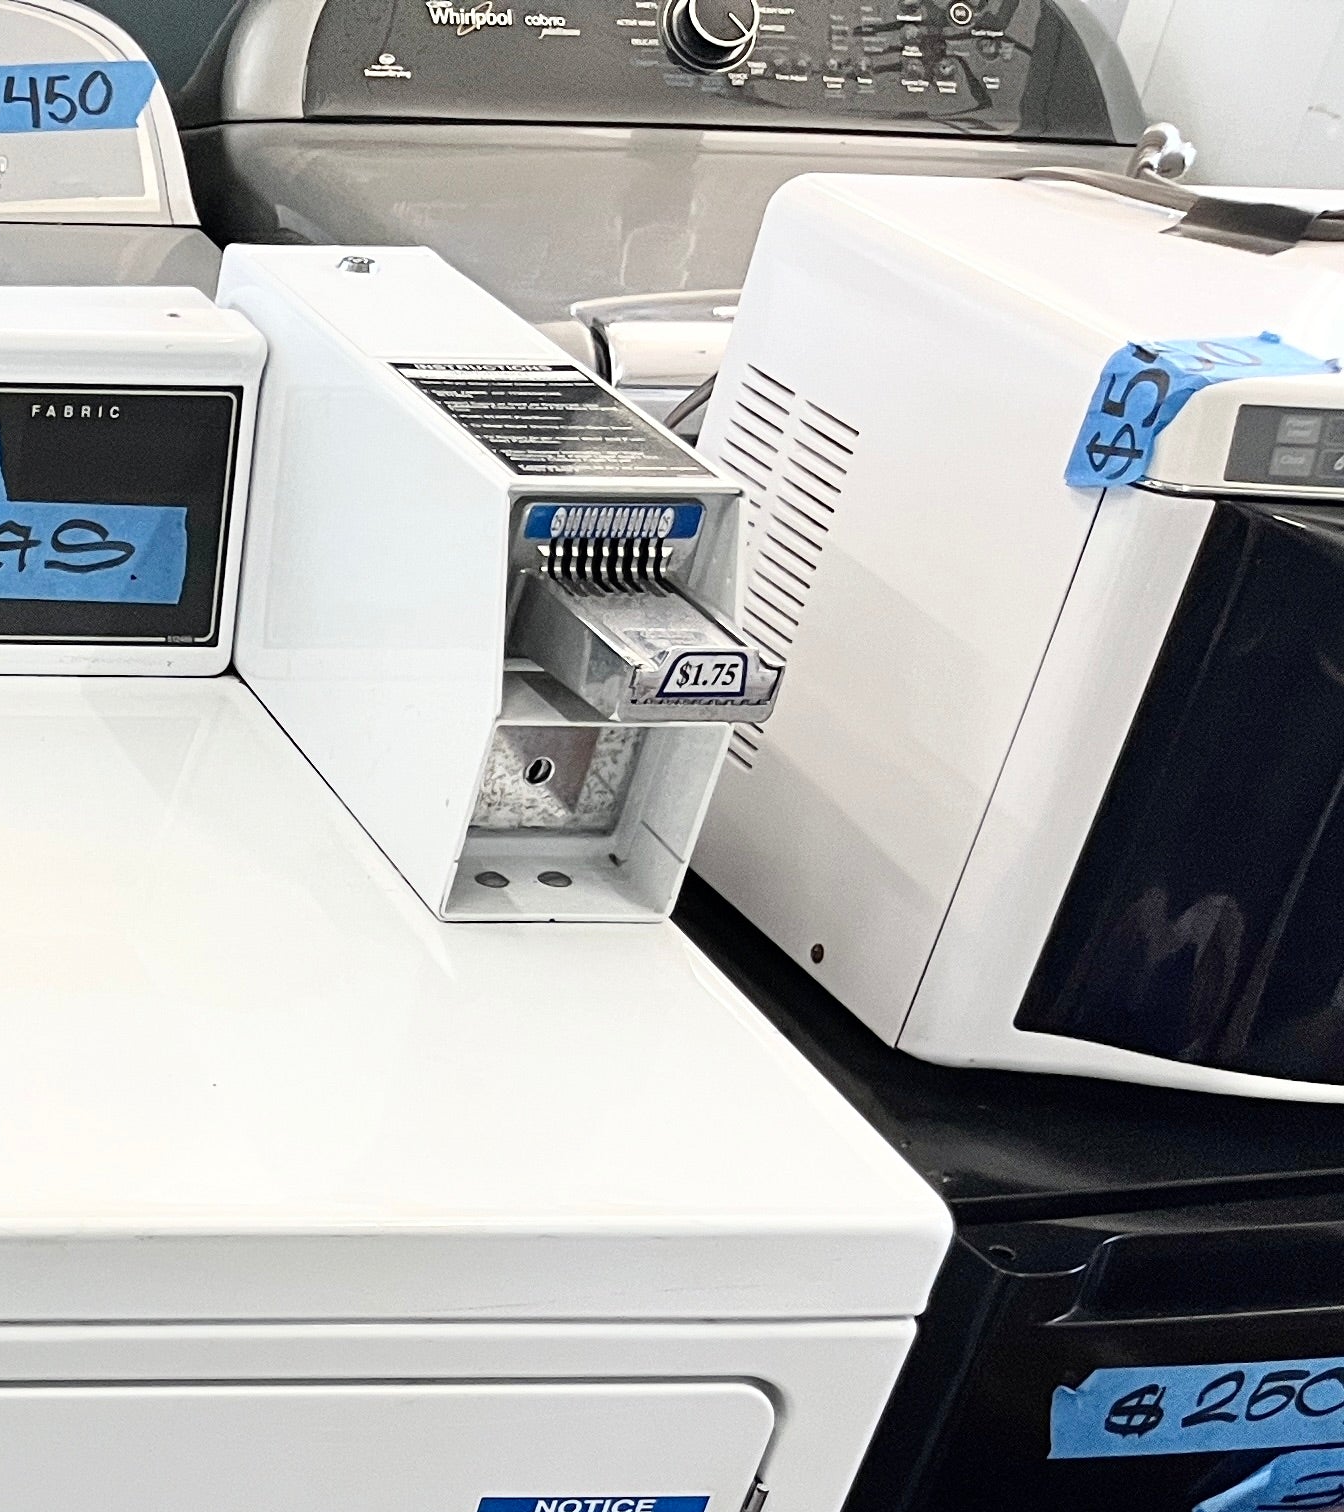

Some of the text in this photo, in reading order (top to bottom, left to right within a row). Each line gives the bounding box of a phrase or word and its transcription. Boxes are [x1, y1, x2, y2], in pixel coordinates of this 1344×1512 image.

[429, 7, 513, 30] Whirlpool
[414, 364, 552, 372] INSTRUCTIONS
[31, 404, 121, 419] FABRIC
[676, 661, 738, 688] $1.75
